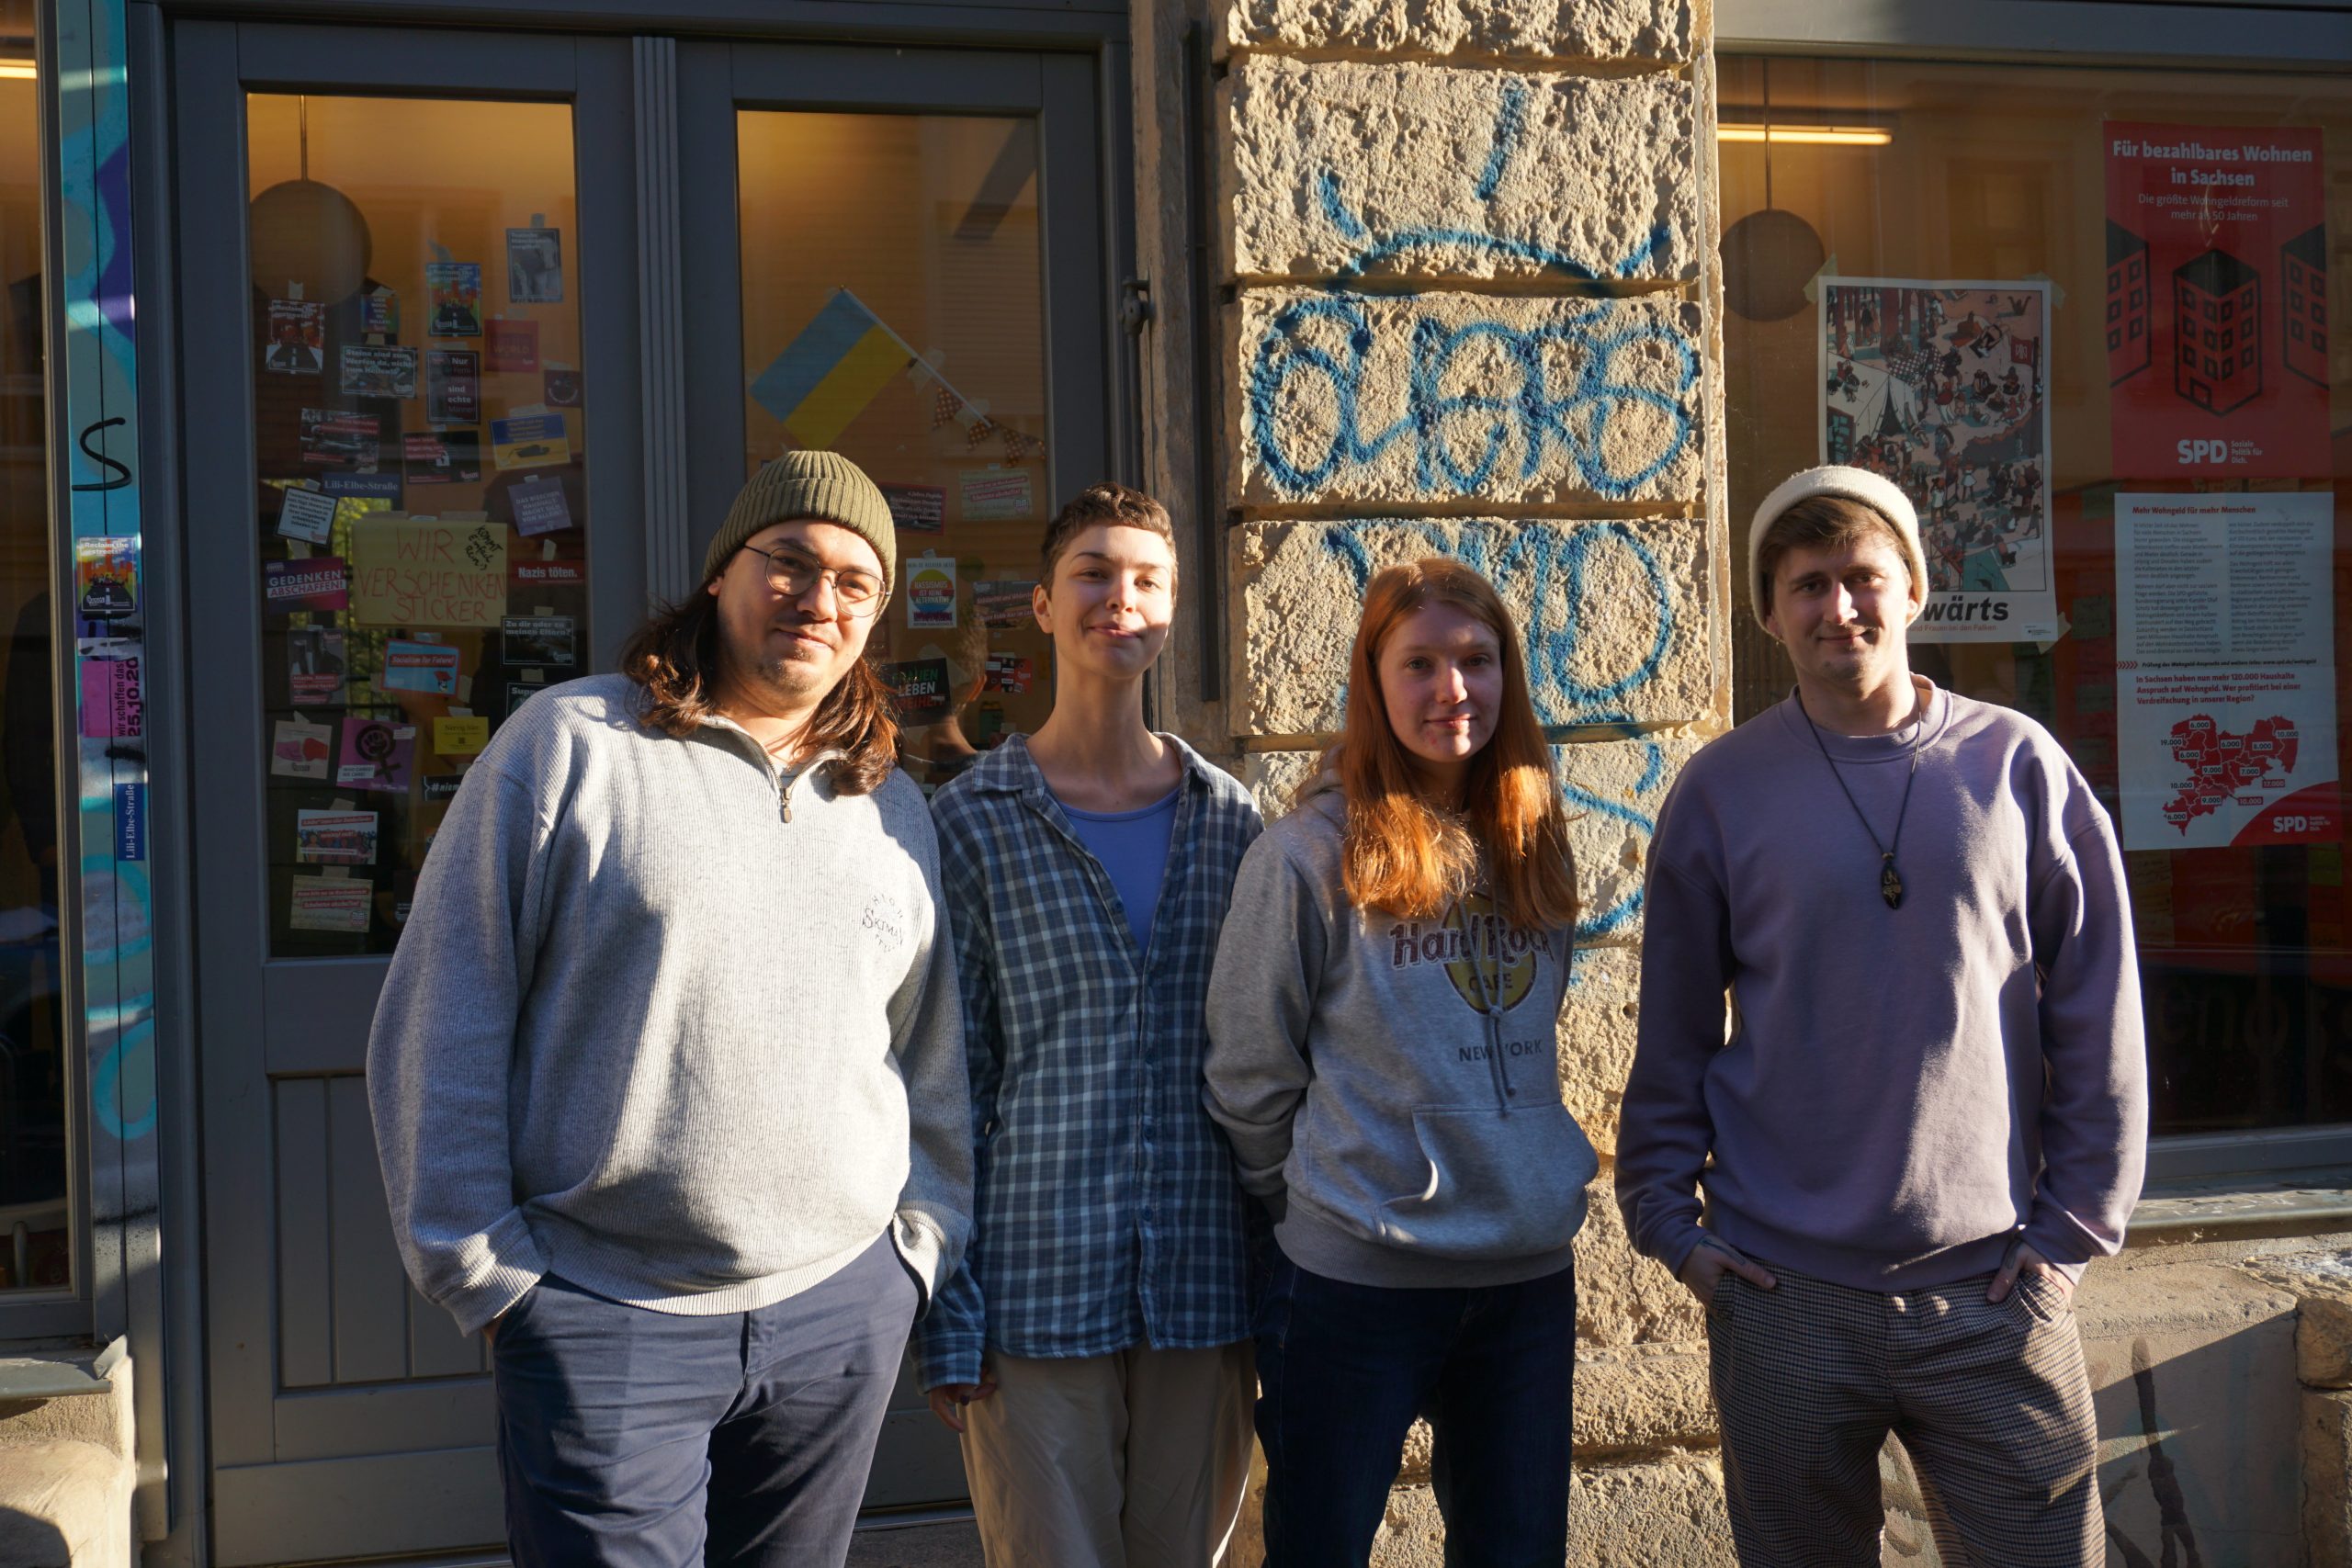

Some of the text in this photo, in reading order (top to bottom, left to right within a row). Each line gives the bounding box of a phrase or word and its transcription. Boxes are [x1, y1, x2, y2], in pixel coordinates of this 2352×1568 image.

[2113, 140, 2312, 163] Für bezahlbares Wohnen
[2171, 167, 2255, 186] in Sachsen
[2139, 193, 2289, 210] Die größte Wohngeldreform seit
[2171, 211, 2197, 220] mehr
[2212, 211, 2223, 221] 50
[2227, 211, 2257, 222] Jahren
[451, 357, 469, 366] Nur
[447, 385, 466, 394] sind
[447, 395, 471, 404] echte
[2231, 440, 2255, 448] Soziale
[2177, 439, 2228, 464] SPD
[2252, 448, 2264, 457] für
[2231, 457, 2248, 465] Dich.
[324, 479, 398, 492] Lili-Elbe-Straße
[2132, 505, 2256, 516] Mehr Wohngeld für mehr Menschen
[475, 525, 504, 552] KOMMT
[397, 526, 456, 564] WIR
[269, 570, 342, 587] GEDENKEN
[518, 567, 578, 579] Nazis töten.
[270, 580, 343, 597] ABSCHAFFEN!
[353, 567, 506, 601] VERSCHENKEN
[915, 595, 949, 604] ALTERNATIVE
[392, 595, 489, 625] STICKER
[1923, 594, 2009, 622] wärts
[2144, 674, 2172, 683] Sachsen
[2174, 673, 2195, 682] haben
[2212, 673, 2230, 682] mehr
[2231, 672, 2259, 682] 120.000
[2260, 671, 2295, 681] Haushalte
[898, 682, 935, 697] LEBEN
[2137, 682, 2301, 695] Anspruch auf Wohngeld. Wer profitiert bei einer
[114, 682, 126, 720] schaffen
[2137, 694, 2255, 706] Verdreifachung in unserer Region?
[116, 722, 126, 737] wir
[2190, 720, 2210, 728] 6.000
[2276, 730, 2299, 739] 10.000
[2161, 738, 2183, 747] 19.000
[2221, 739, 2240, 749] 6.000
[2179, 750, 2199, 759] 6.000
[2203, 765, 2222, 774] 9.000
[2241, 766, 2259, 775] 7.000
[2170, 781, 2193, 789] 10.000
[2201, 795, 2222, 805] 9.000
[124, 784, 135, 860] Lili-Elbe-Straße
[2167, 812, 2187, 821] 6.000
[2273, 815, 2307, 833] SPD
[1389, 913, 1556, 970] Hard Rock
[1469, 973, 1513, 992] CAFE
[1459, 1038, 1544, 1063] NEW ORK
